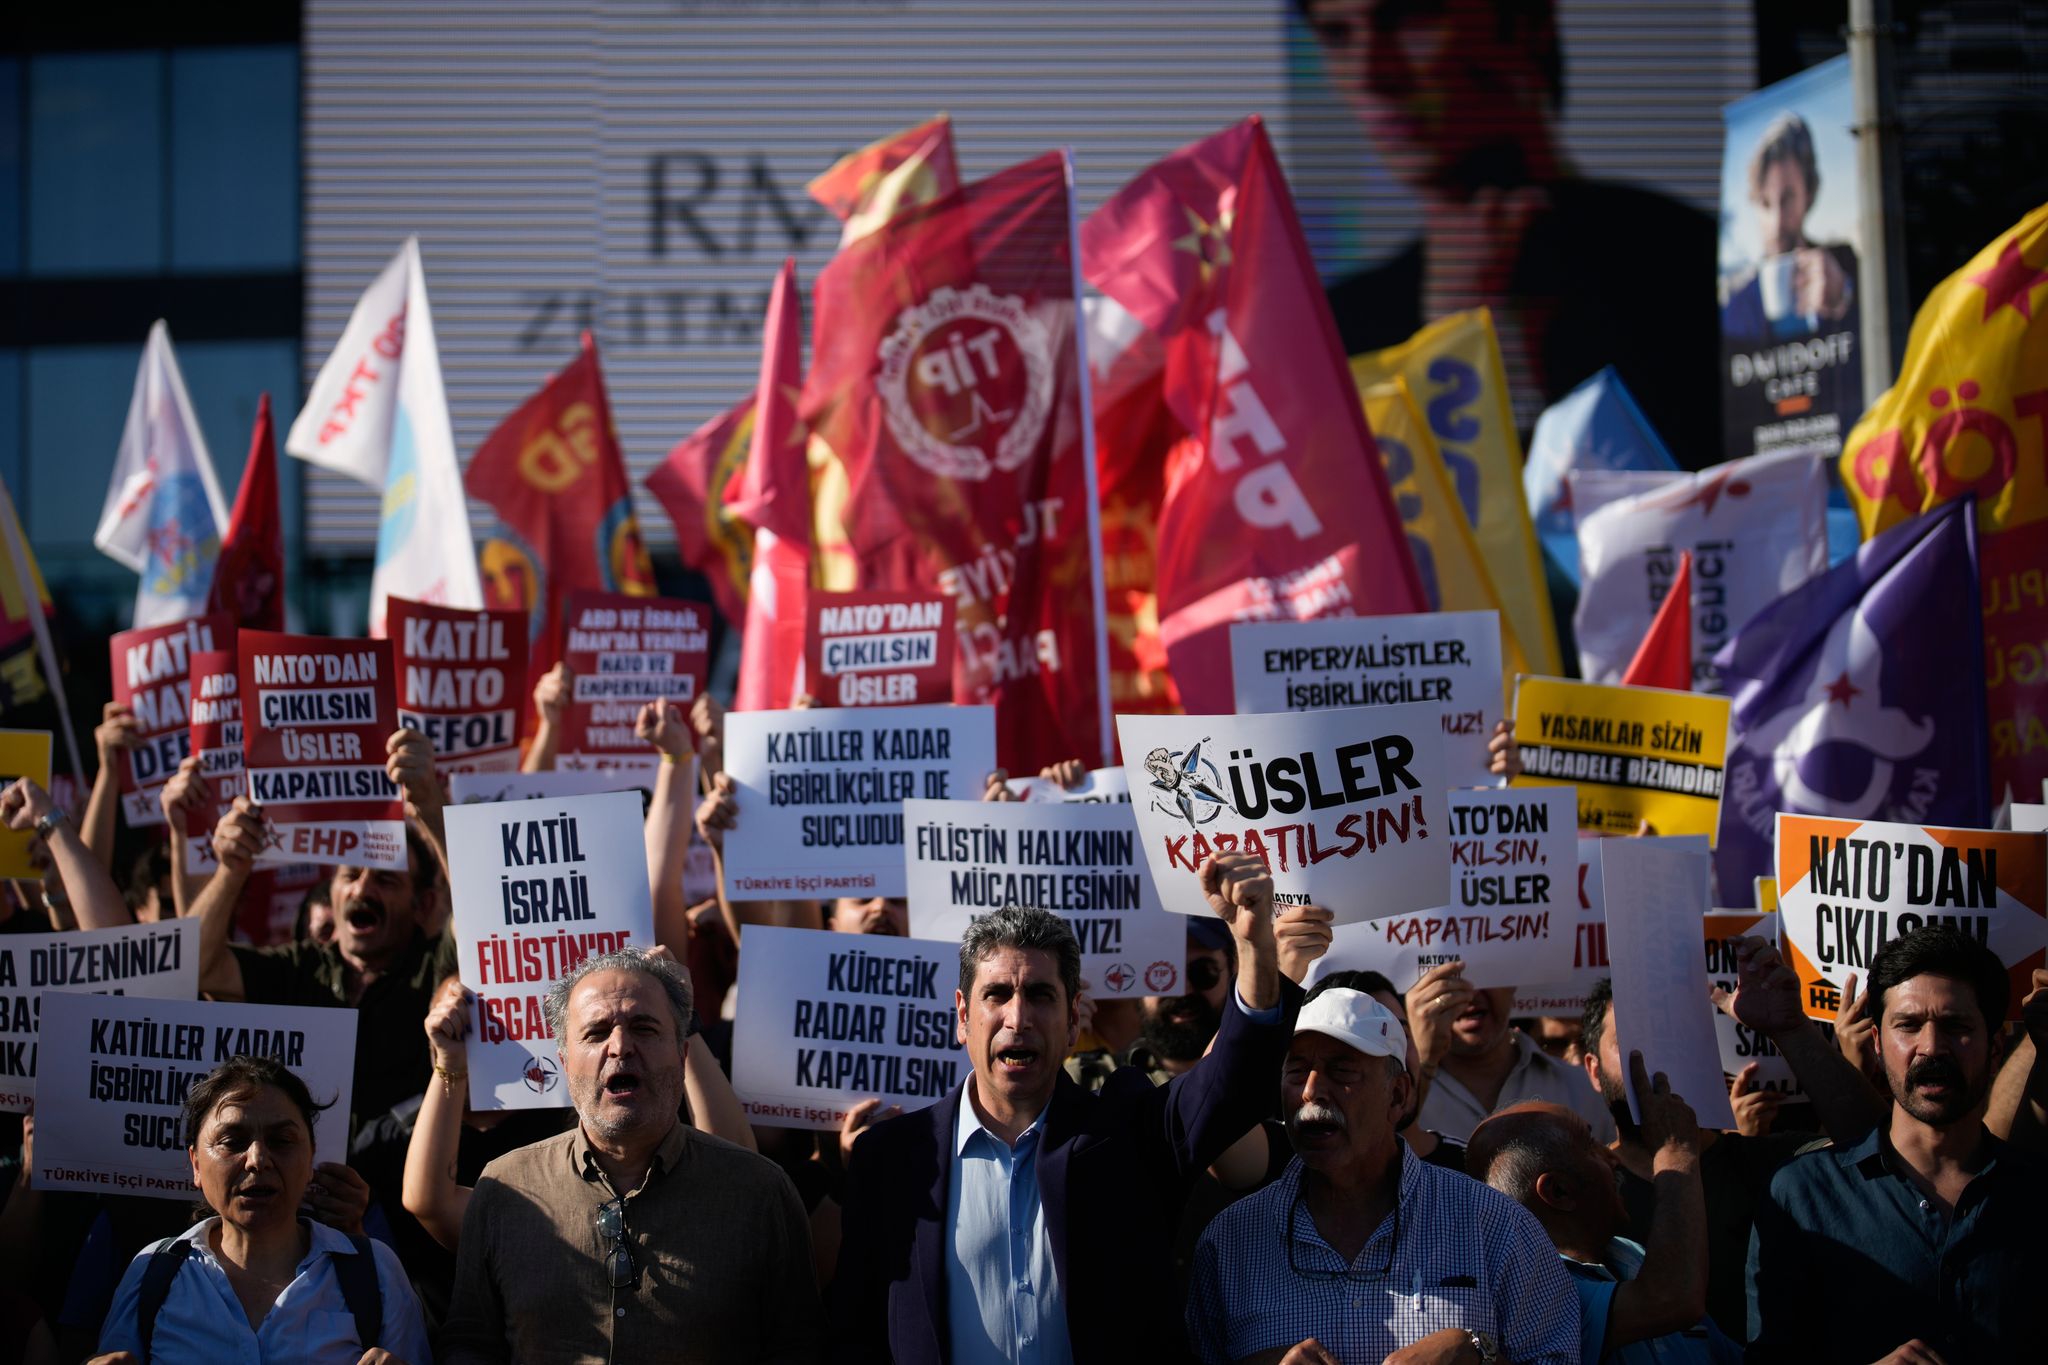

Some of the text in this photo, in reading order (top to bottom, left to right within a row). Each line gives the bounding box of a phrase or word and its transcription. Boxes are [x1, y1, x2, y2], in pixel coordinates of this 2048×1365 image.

[404, 613, 510, 661] KATİL
[820, 601, 943, 635] NATO'DAN
[254, 651, 377, 685] NATO'DAN
[602, 656, 667, 673] NATO VE
[828, 637, 931, 676] ÇIKILSIN
[1264, 634, 1472, 674] EMPERYALİSTLER,
[200, 672, 237, 699] ABD
[406, 665, 505, 708] NATO
[839, 672, 918, 706] ÜSLER
[1286, 674, 1453, 710] İŞBİRLİKÇİLER
[264, 691, 372, 729] ÇIKILSIN
[281, 728, 362, 762] ÜSLER
[767, 727, 950, 763] KATİLLER KADAR
[1540, 712, 1703, 754] YASAKLAR SİZİN
[253, 770, 399, 800] KAPATILSIN
[769, 768, 950, 808] İŞBİRLİKÇİLER DE
[1230, 734, 1422, 820] ÜSLER
[1520, 745, 1724, 798] MÜCADELE BİZİMDİR!
[802, 812, 904, 848] SUÇLUDU
[1164, 795, 1429, 874] KAPATILSIN!
[1449, 804, 1548, 836] TO'DAN
[292, 828, 359, 857] EHP
[501, 812, 586, 867] KATİL
[917, 821, 1133, 866] FİLİSTİN HALKININ
[1450, 839, 1548, 867] KILSIN,
[734, 873, 876, 892] TÜRKİYE İŞÇİ PARTİSİ
[950, 866, 1141, 911] MÜCADELESİNİN
[1460, 869, 1551, 907] ÜSLER
[1810, 835, 1998, 909] NATO'DAN
[501, 869, 597, 926] İSRAİL
[1272, 892, 1312, 906] ATO'YA
[1386, 911, 1549, 948] KAPATILSIN!
[30, 928, 181, 987] DÜZENİNİZİ
[827, 950, 940, 1000] KÜRECİK
[1542, 994, 1584, 1010] PARTİS
[794, 999, 886, 1045] RADAR
[90, 1018, 305, 1067] KATİLLER KADAR
[796, 1048, 958, 1099] KAPATILSIN!
[742, 1101, 802, 1120] TÜRKİYE
[805, 1108, 831, 1124] İŞÇİ
[43, 1167, 202, 1192] TÜRKİYE İŞÇİ PARTİS
